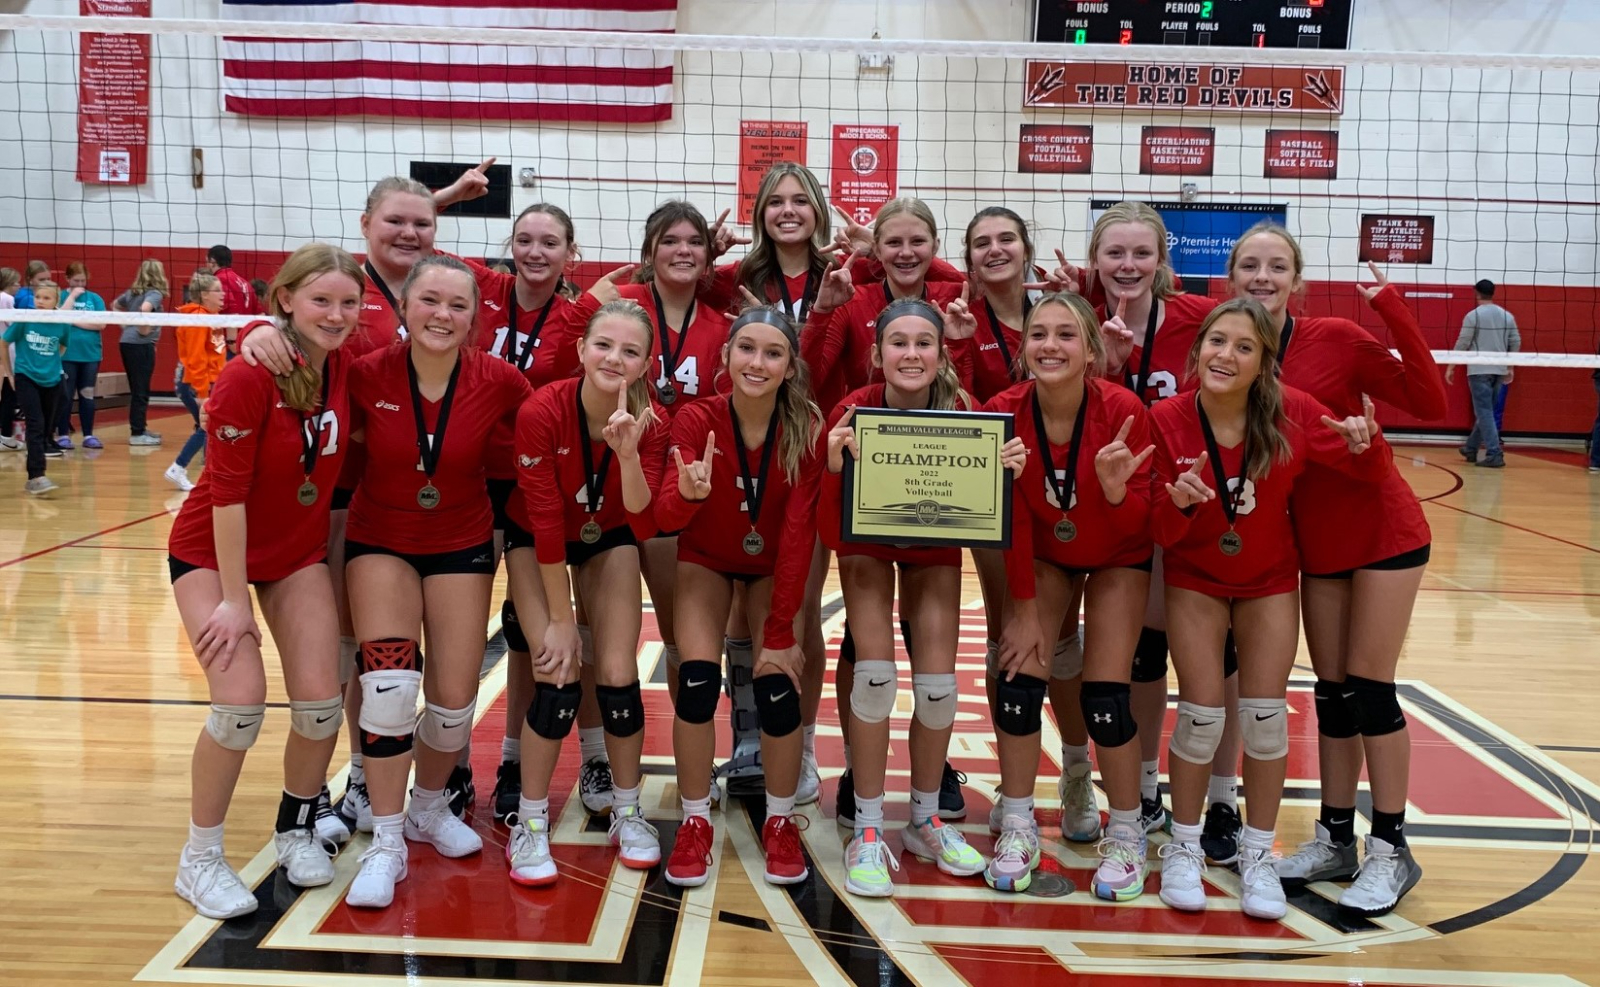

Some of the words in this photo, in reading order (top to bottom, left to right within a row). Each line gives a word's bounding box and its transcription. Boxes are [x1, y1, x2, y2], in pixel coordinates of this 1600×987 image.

[1076, 2, 1109, 14] BONUS
[1165, 2, 1200, 14] PERIOD
[1201, 2, 1213, 18] 2
[1280, 7, 1312, 18] BONUS
[1065, 19, 1089, 28] FOULS
[1120, 20, 1133, 29] TOL
[1161, 21, 1188, 30] PLAYER
[1196, 22, 1219, 31] FOULS
[1252, 23, 1266, 32] TOL
[1298, 25, 1322, 33] FOULS
[1120, 29, 1132, 44] 2
[1128, 65, 1199, 86] HOME
[1210, 67, 1242, 86] OF
[1075, 84, 1127, 105] THE
[1137, 86, 1188, 106] RED
[1198, 87, 1293, 108] DEVILS
[1022, 135, 1047, 143] CROSS
[1050, 136, 1090, 144] COUNTRY
[1145, 137, 1210, 146] CHEERLEADING
[1034, 145, 1077, 153] FOOTBALL
[1280, 140, 1323, 149] BASEBALL
[1150, 146, 1205, 155] BASKETBALL
[1280, 149, 1322, 158] SOFTBALL
[1028, 153, 1082, 162] VOLLEYBALL
[1153, 155, 1202, 164] WRESTLING
[1268, 159, 1296, 167] TRACK
[1299, 159, 1306, 167] &
[1309, 159, 1335, 168] FIELD
[1377, 219, 1402, 227] THANK
[1181, 236, 1220, 247] Premier
[1391, 242, 1423, 250] SUPPORT
[1180, 248, 1200, 256] Upper
[1201, 248, 1221, 256] Valley
[487, 326, 541, 371] 15
[656, 355, 699, 395] 14
[886, 425, 911, 433] MIAMI
[943, 428, 975, 436] LEAGUE
[871, 452, 988, 469] CHAMPION
[905, 478, 920, 486] 8th
[923, 479, 953, 488] Grade
[905, 488, 953, 498] Volleyball
[1226, 477, 1256, 515] 3
